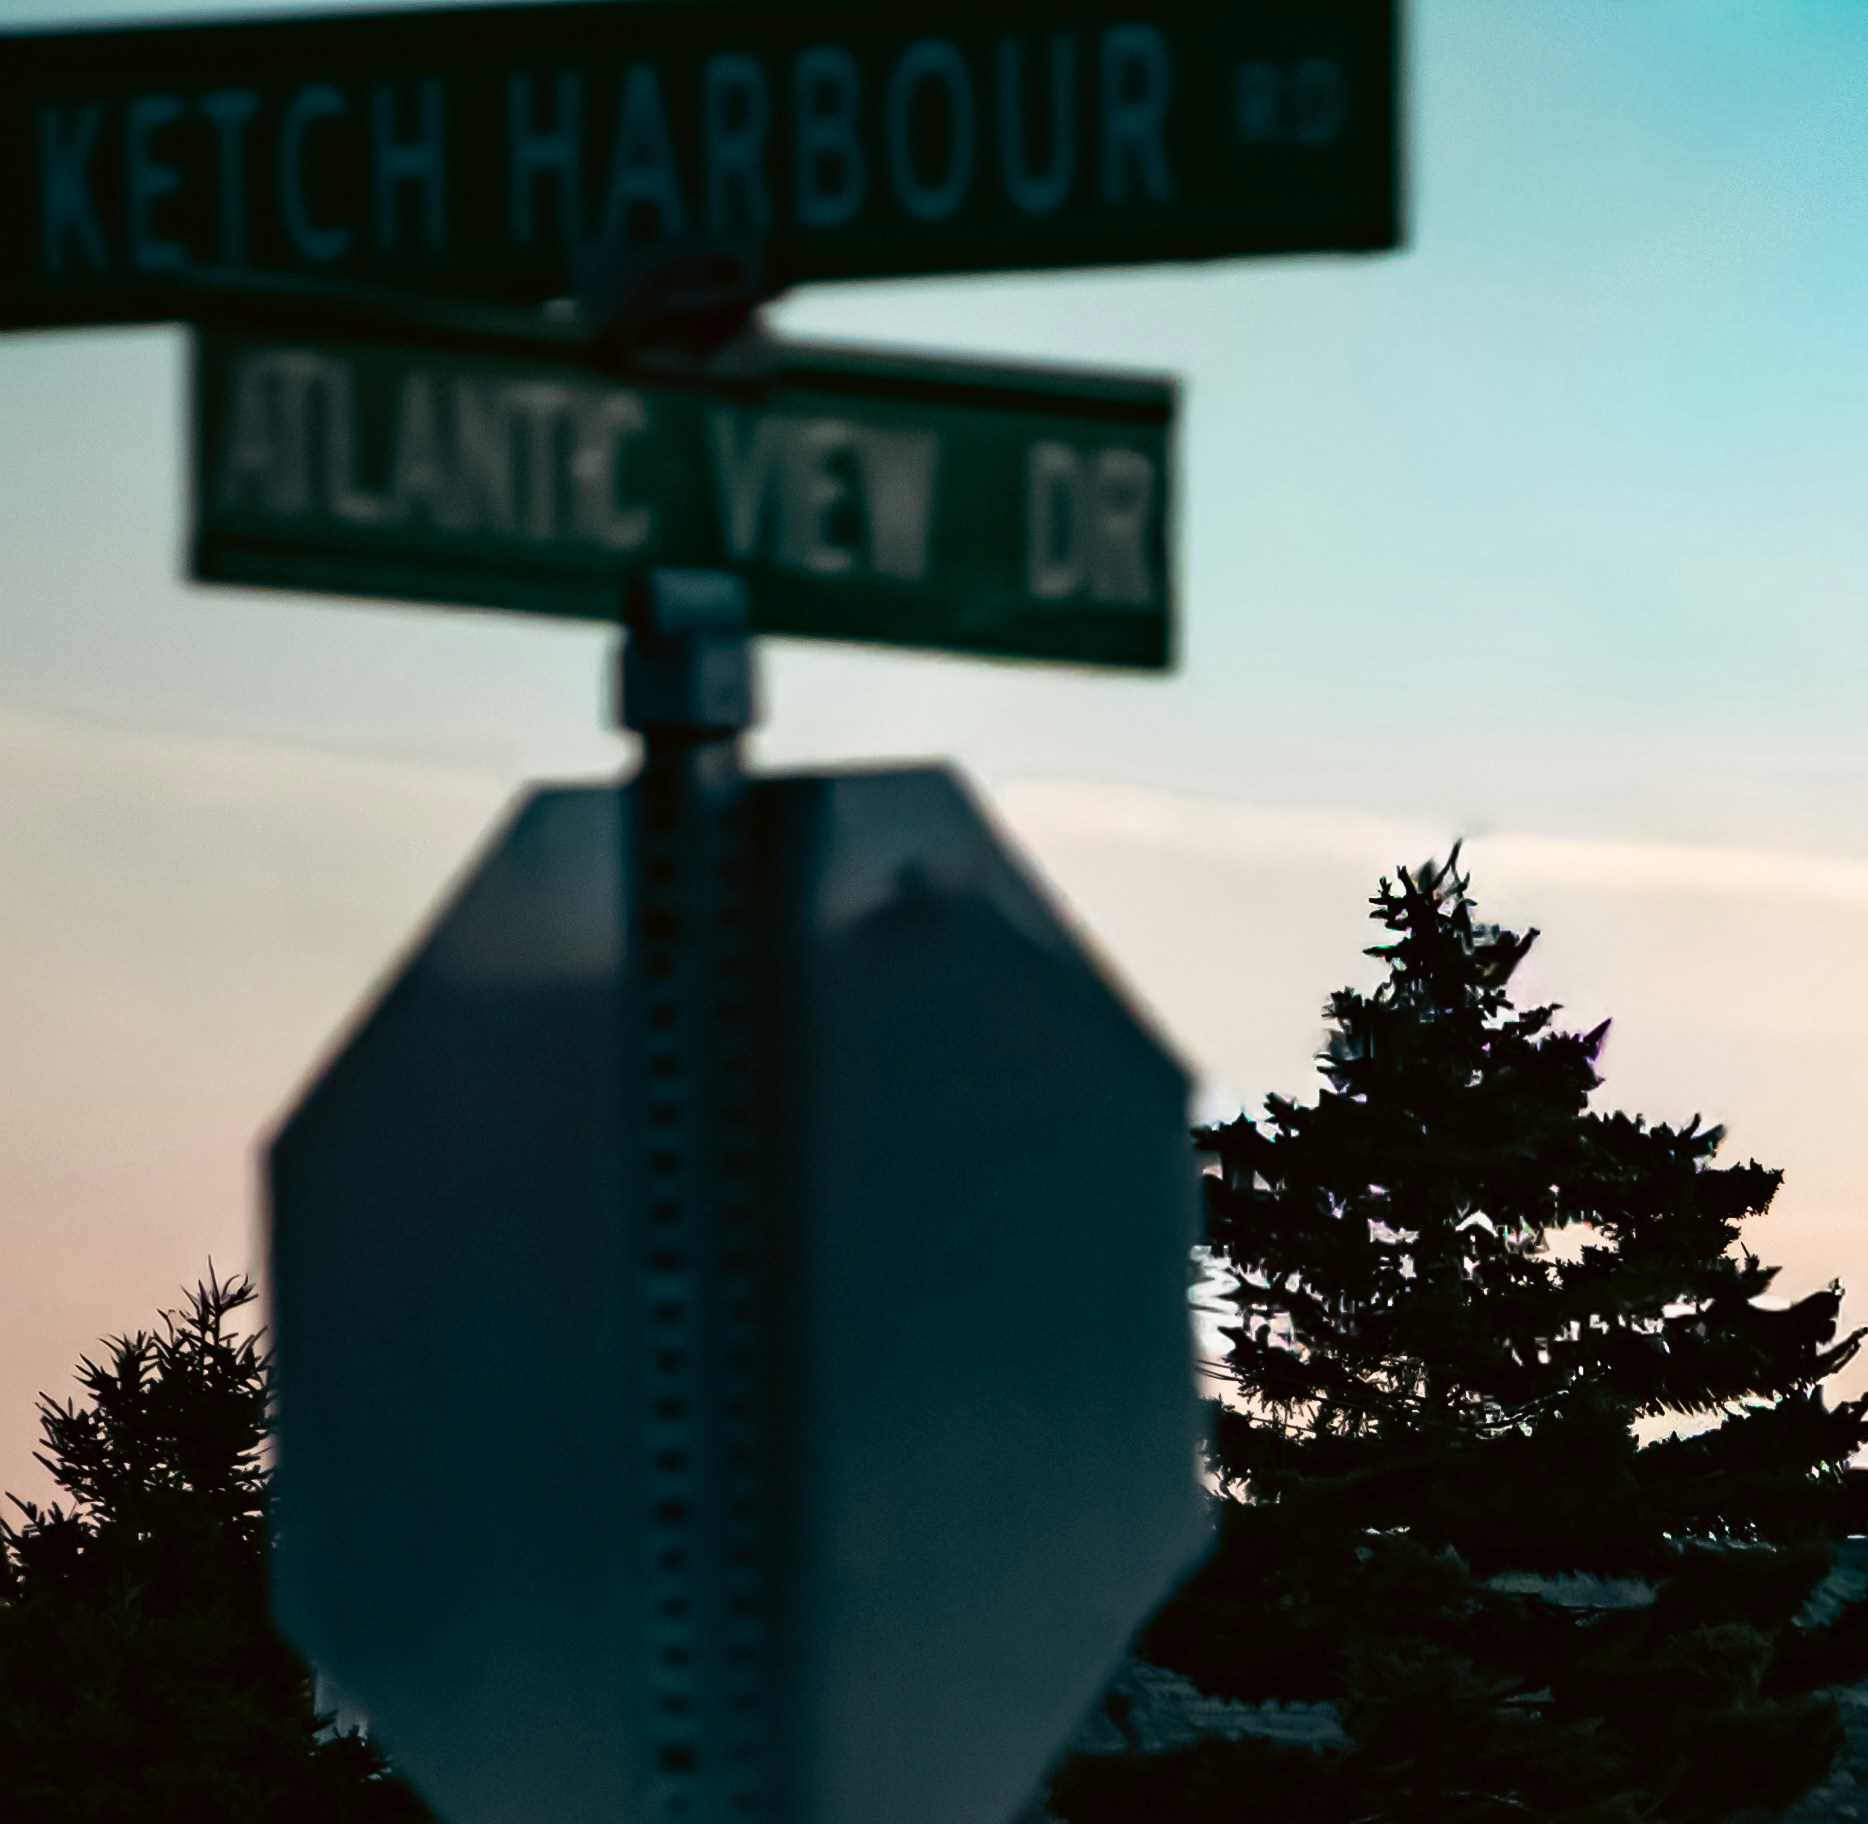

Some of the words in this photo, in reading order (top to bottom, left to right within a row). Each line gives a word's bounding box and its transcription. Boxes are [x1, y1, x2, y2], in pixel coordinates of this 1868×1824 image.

[34, 82, 456, 276] KETCH
[503, 19, 1180, 250] HARBOUR
[216, 348, 652, 554] ATLANTIC
[708, 412, 940, 582] VIEW
[1026, 438, 1158, 606] DR
